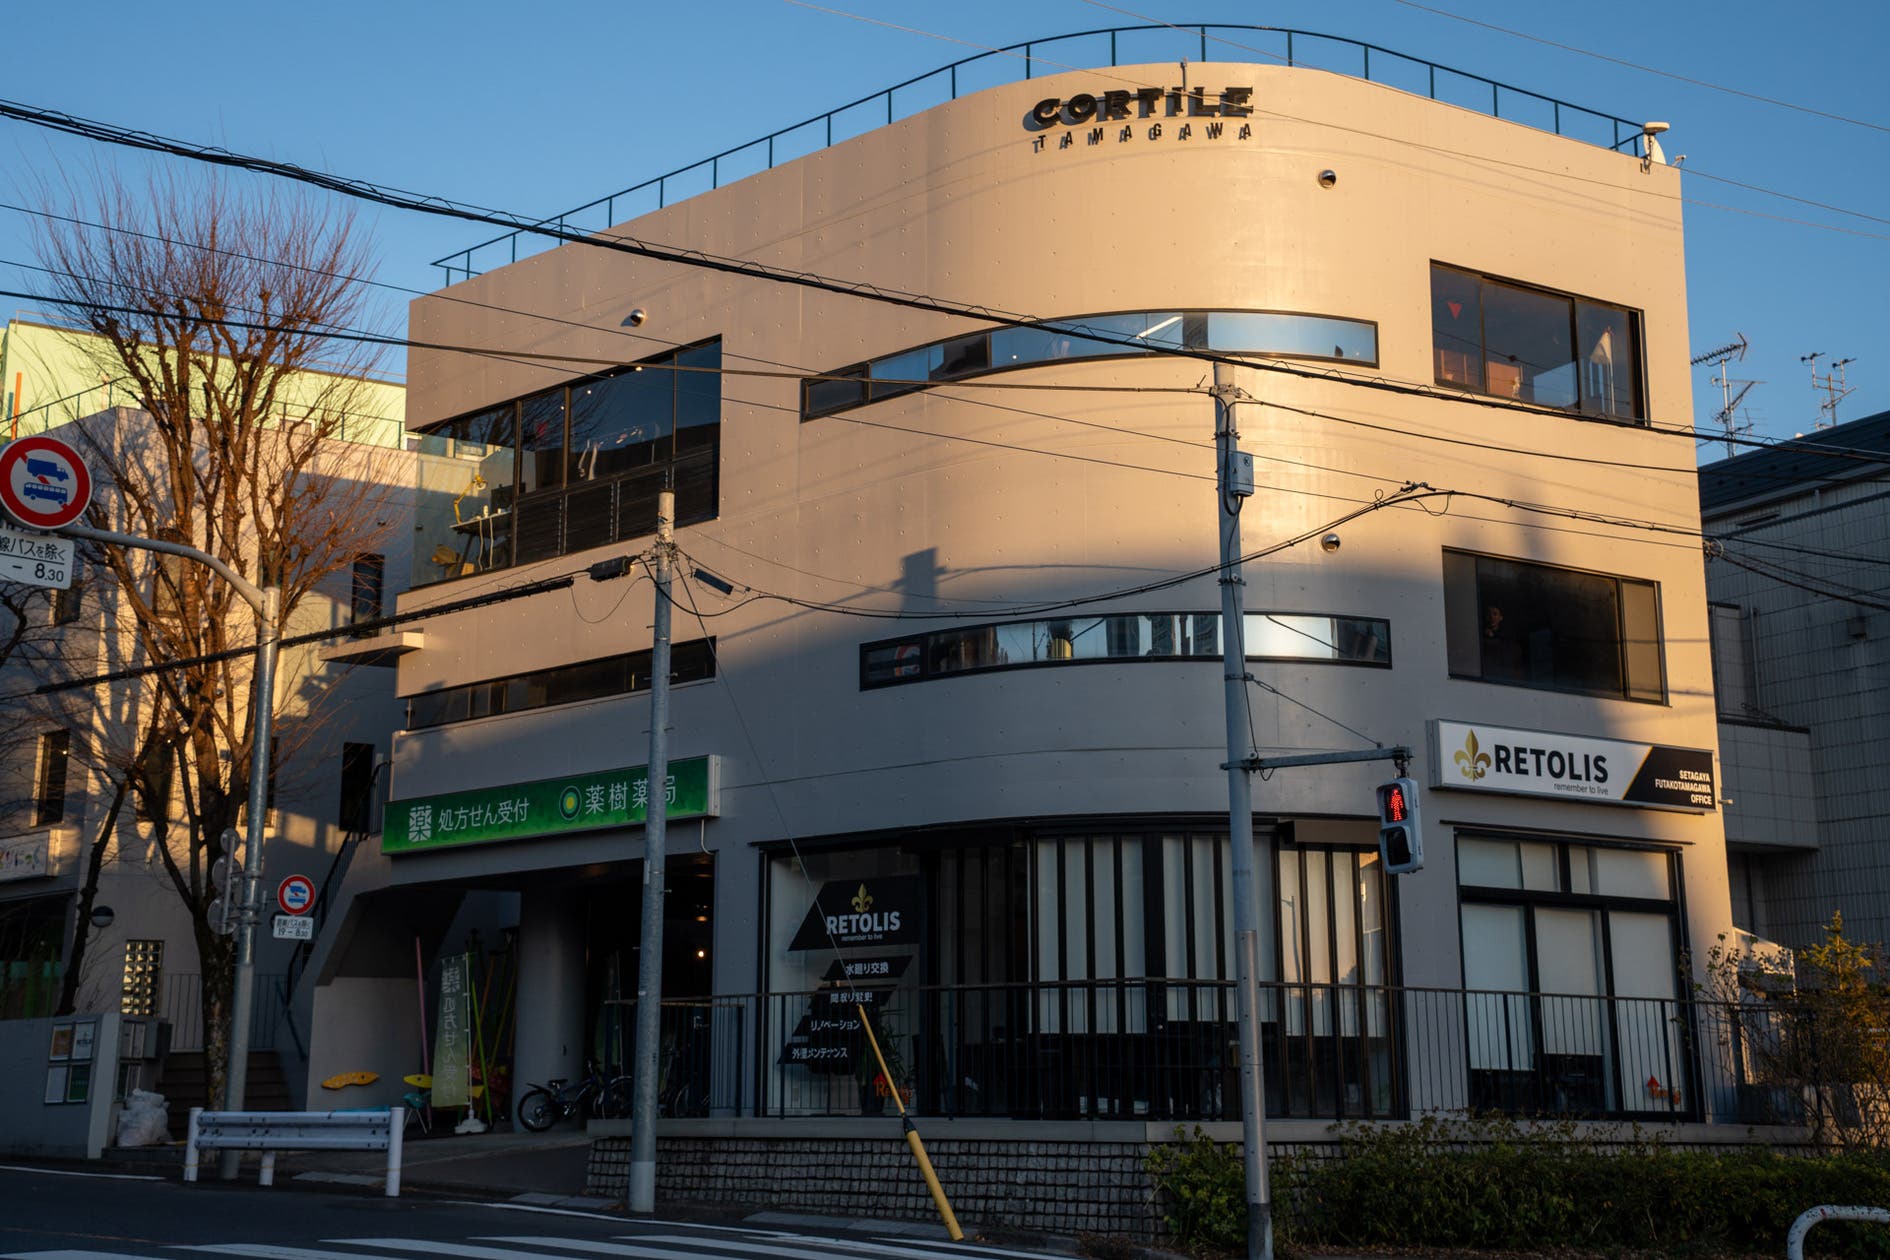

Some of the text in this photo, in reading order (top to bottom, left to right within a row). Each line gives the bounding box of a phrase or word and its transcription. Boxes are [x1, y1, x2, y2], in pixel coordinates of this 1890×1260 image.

[1032, 86, 1254, 127] CORTILE
[1036, 122, 1252, 150] TAMAGAWA
[35, 563, 64, 582] 8.30
[1494, 744, 1609, 784] RETOLIS
[1679, 770, 1711, 782] SETAGAYA
[1553, 783, 1609, 796] remember to live
[1655, 778, 1712, 794] FUTAKOTAMAGAWA
[1690, 794, 1712, 805] OFFICE
[408, 797, 530, 842] 薬 処方せん受付
[826, 911, 902, 935] RETOLIS
[810, 1019, 861, 1031] リノベーション
